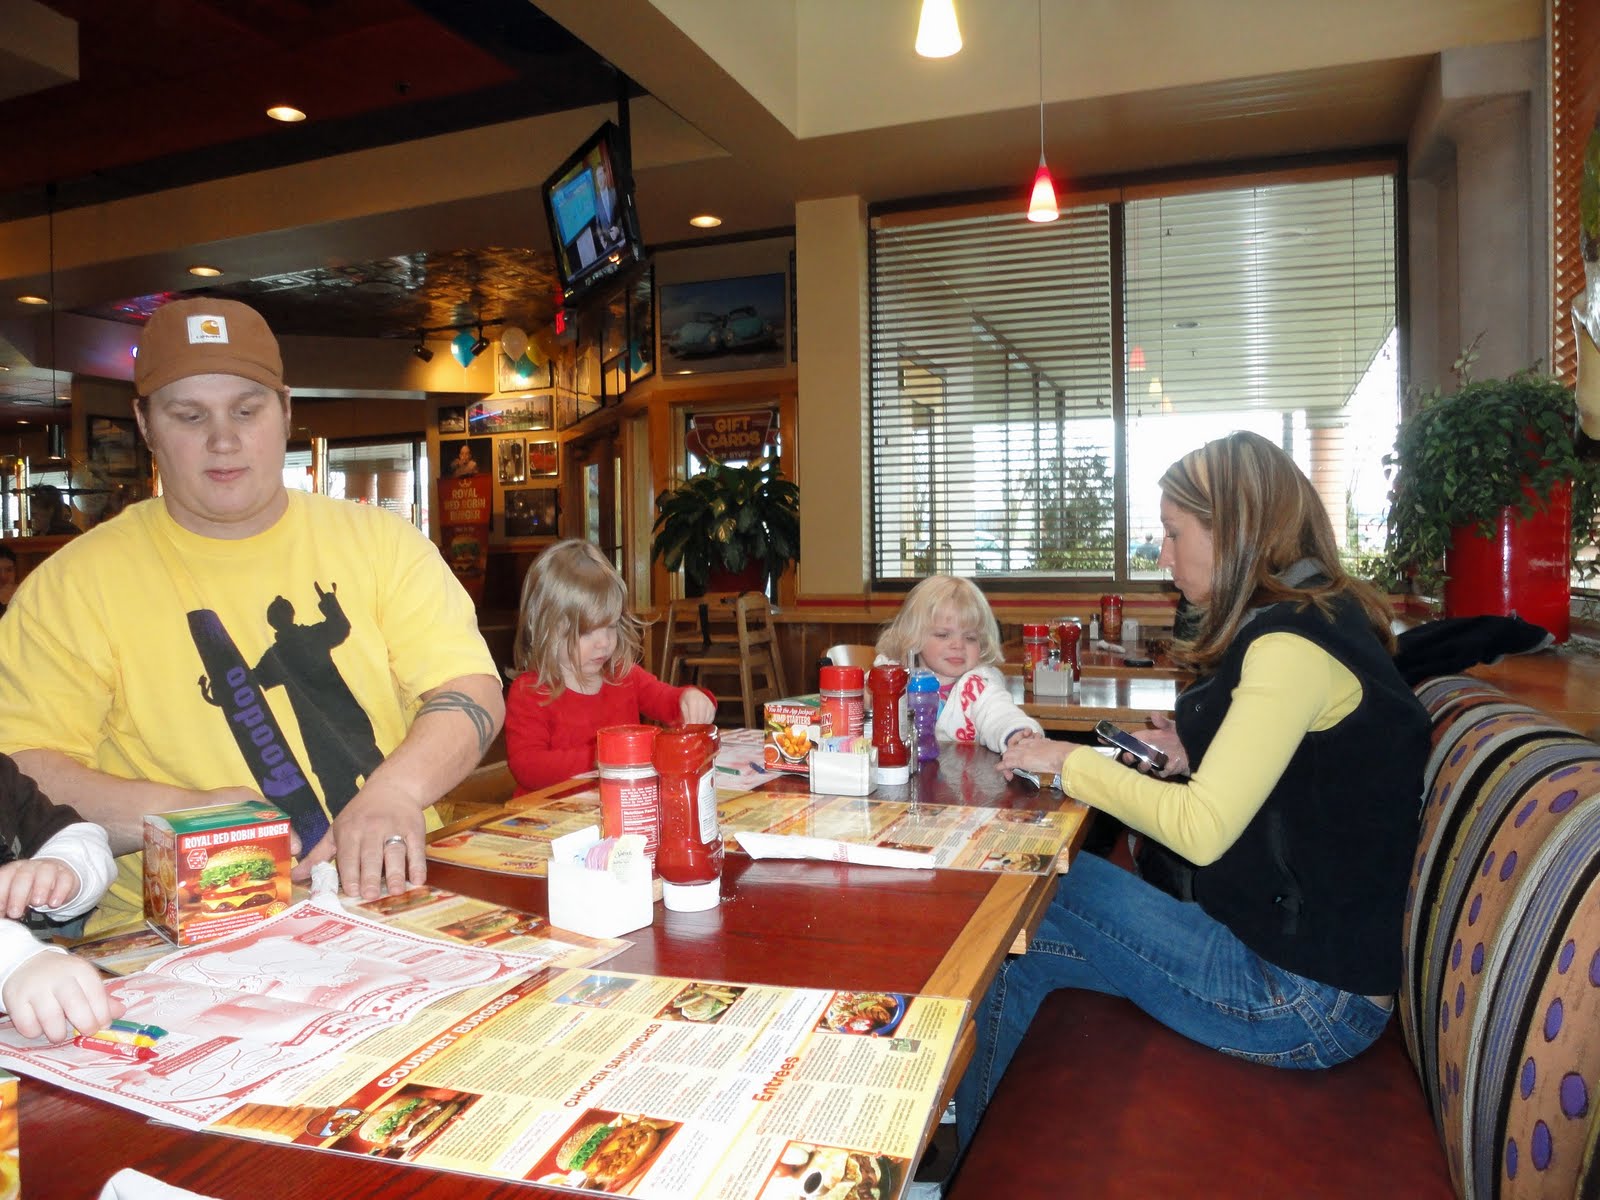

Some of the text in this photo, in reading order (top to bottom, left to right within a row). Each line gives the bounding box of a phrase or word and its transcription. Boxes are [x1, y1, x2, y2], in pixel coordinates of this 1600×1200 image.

[714, 416, 751, 433] GIFT
[707, 430, 760, 449] CARDS
[452, 488, 478, 499] ROYAL
[184, 835, 212, 849] ROYAL
[213, 832, 230, 845] RED
[231, 828, 256, 842] ROBIN
[258, 823, 289, 838] BURGER
[377, 1033, 459, 1088] GOURMET
[452, 994, 520, 1034] BURGERS
[564, 1070, 611, 1108] CHICKEN
[605, 1023, 662, 1070] SANDWICHES
